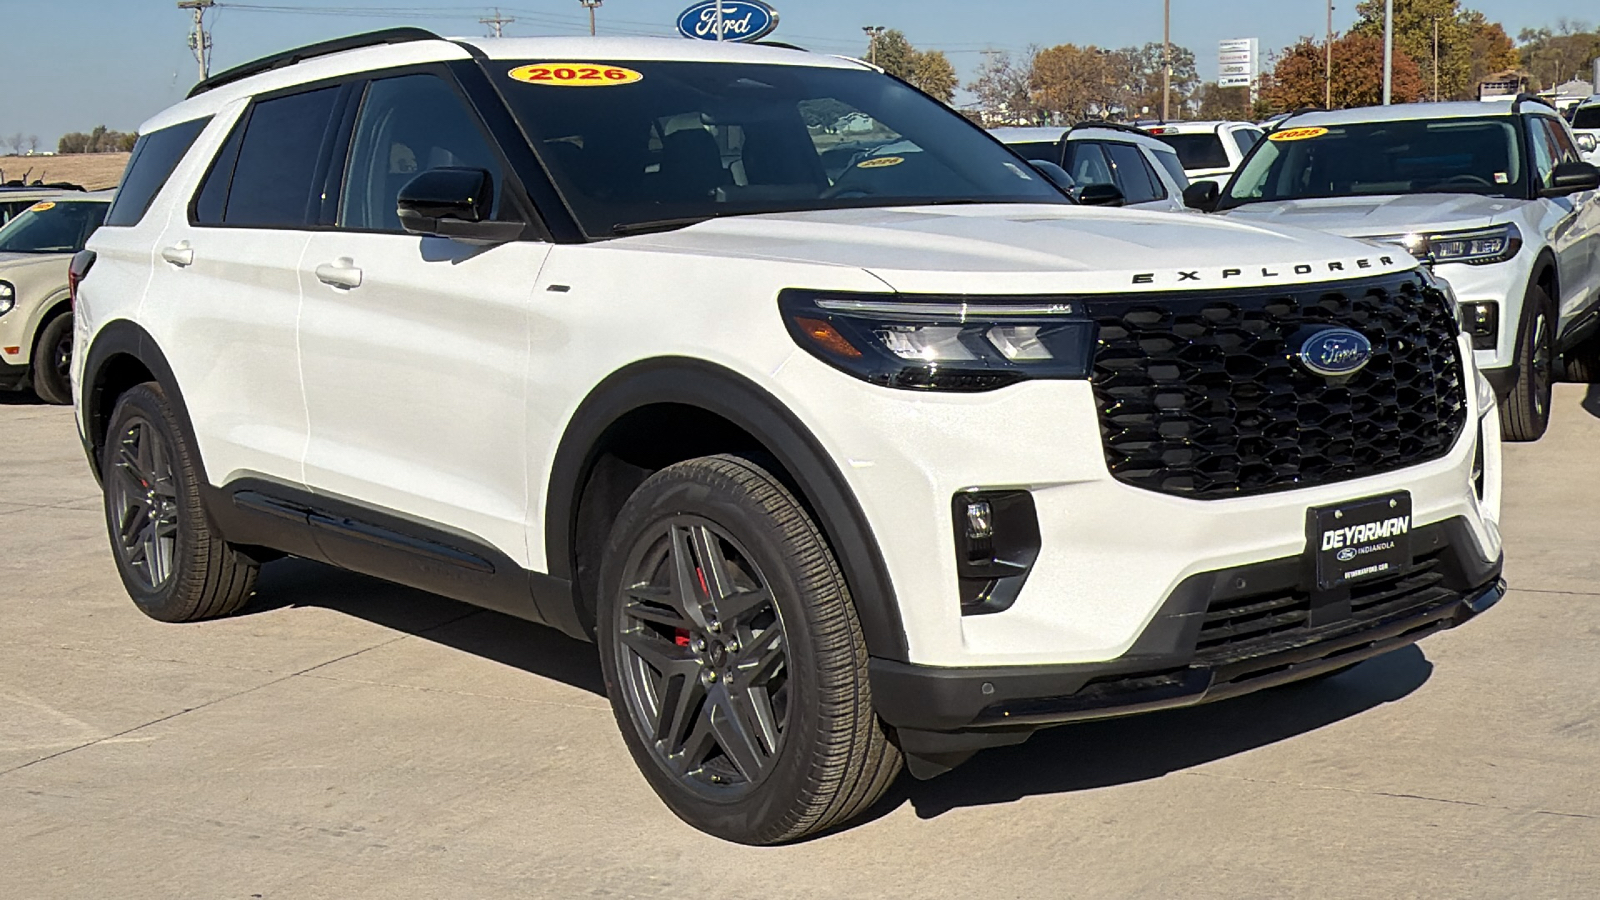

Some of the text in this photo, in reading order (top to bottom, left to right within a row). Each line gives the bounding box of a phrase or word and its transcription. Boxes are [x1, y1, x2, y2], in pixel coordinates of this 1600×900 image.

[528, 68, 627, 80] 2026
[1275, 128, 1322, 139] 2025
[1132, 256, 1394, 284] EXPLORER
[1321, 338, 1363, 365] Ford
[1321, 516, 1410, 551] DEYARMAN
[1358, 541, 1395, 554] INDIANOLA
